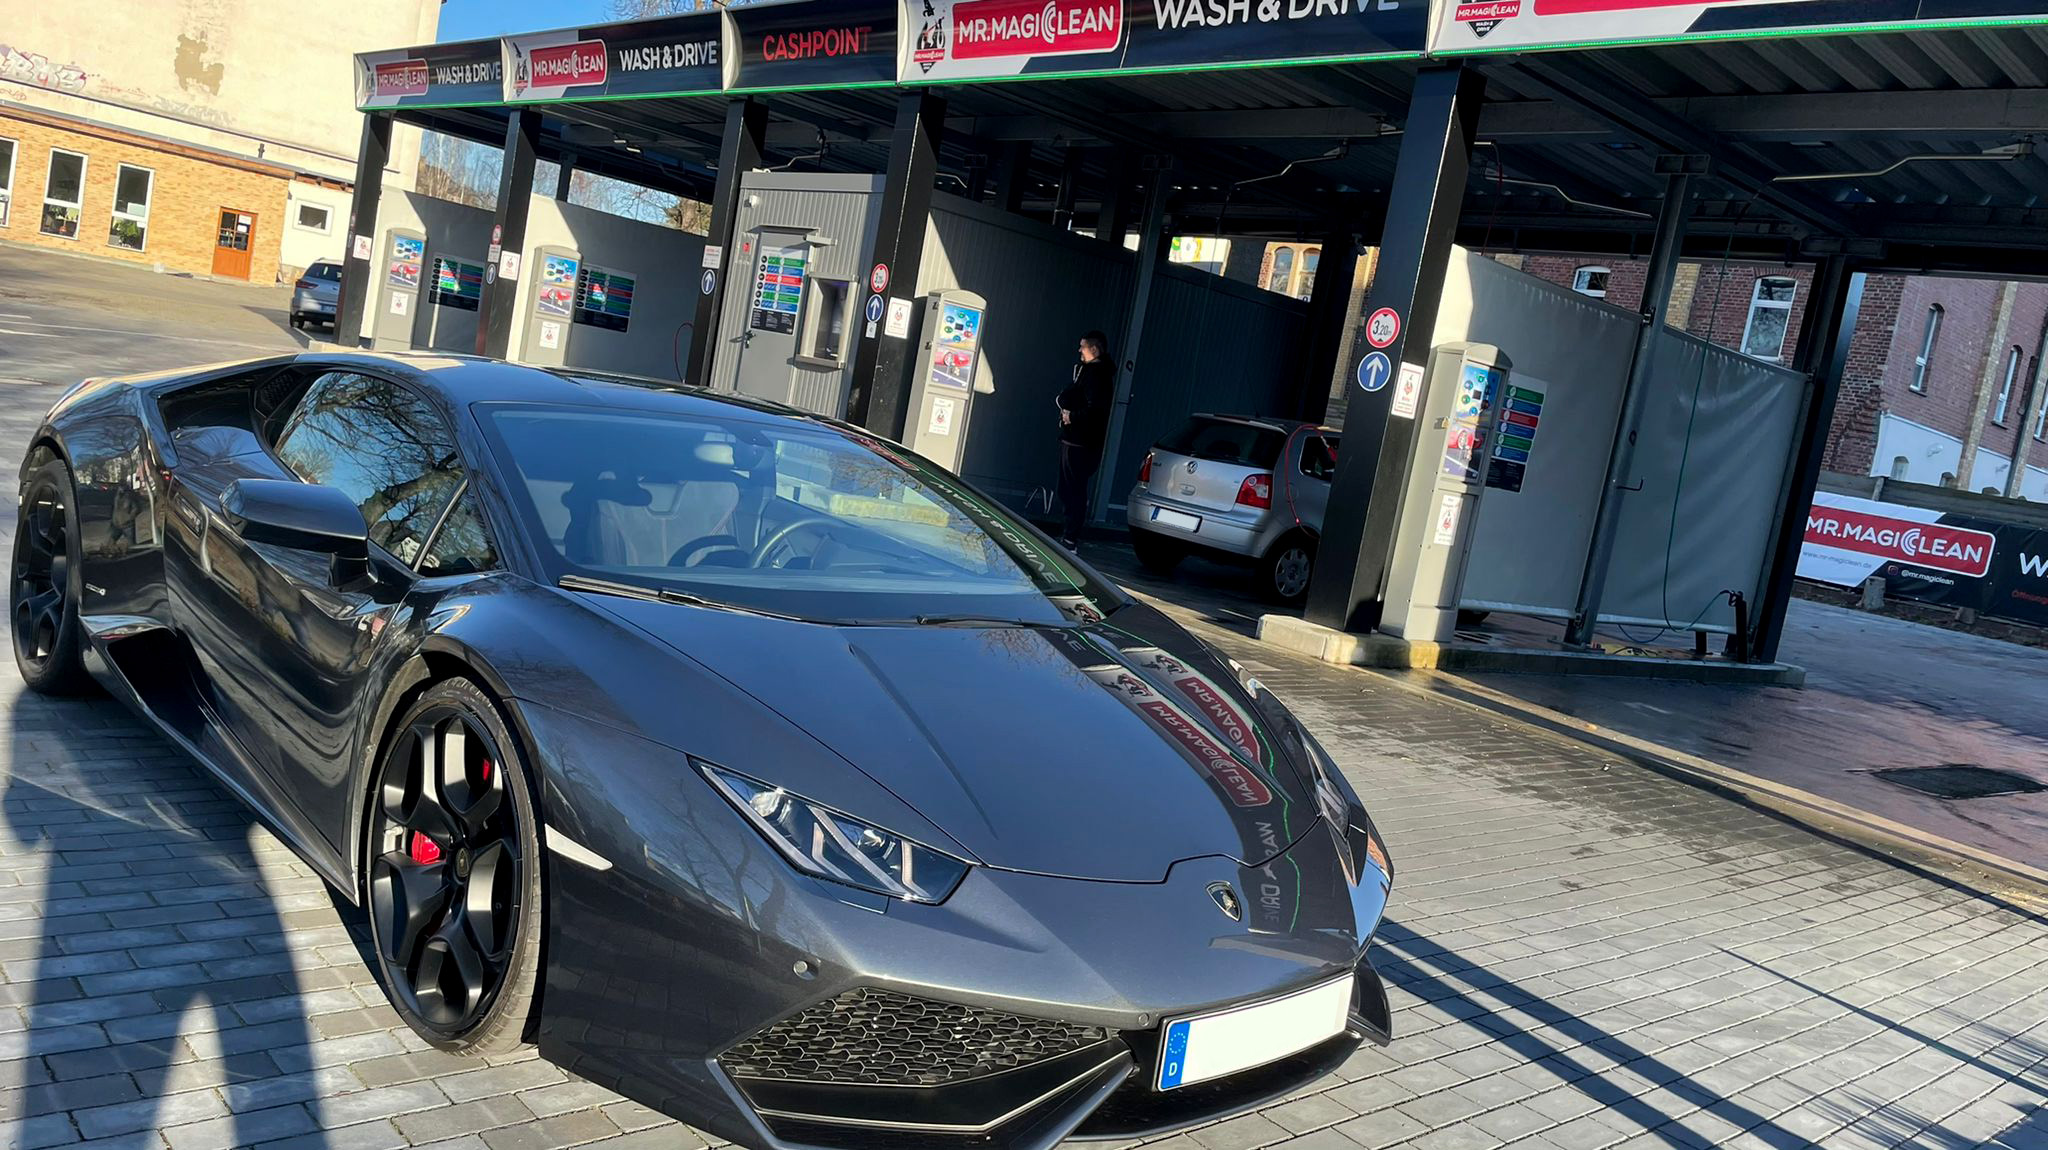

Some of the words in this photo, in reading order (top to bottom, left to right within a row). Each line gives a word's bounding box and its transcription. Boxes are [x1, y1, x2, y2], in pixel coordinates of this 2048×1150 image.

[959, 2, 1114, 44] MR.MAGICLEAN
[1154, 0, 1249, 30] WASH
[619, 46, 660, 72] WASH
[662, 45, 672, 69] &
[674, 40, 717, 67] DRIVE
[763, 26, 872, 61] CASHPOINT
[436, 65, 463, 85] WASH
[465, 65, 472, 83] &
[473, 61, 501, 83] DRIVE
[534, 50, 603, 78] MR.MAGICLEAN
[1805, 515, 1983, 563] MR.MAGICLEAN
[1901, 569, 1954, 585] @mr.magiclean
[1168, 1062, 1178, 1077] D
